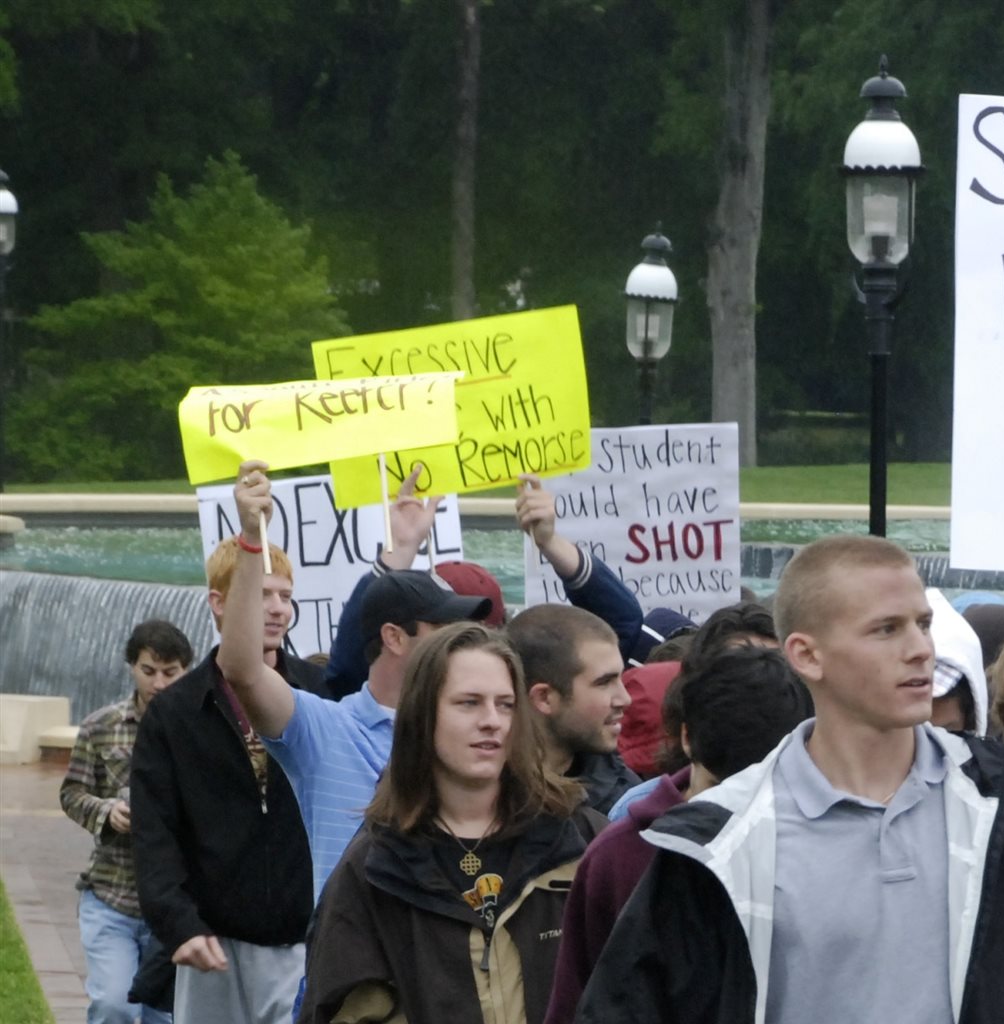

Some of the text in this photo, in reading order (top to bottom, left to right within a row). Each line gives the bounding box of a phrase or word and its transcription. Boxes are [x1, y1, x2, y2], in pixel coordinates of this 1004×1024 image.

[376, 451, 433, 493] No
[598, 428, 722, 474] student
[554, 482, 720, 520] ould have
[624, 519, 734, 565] SHOT
